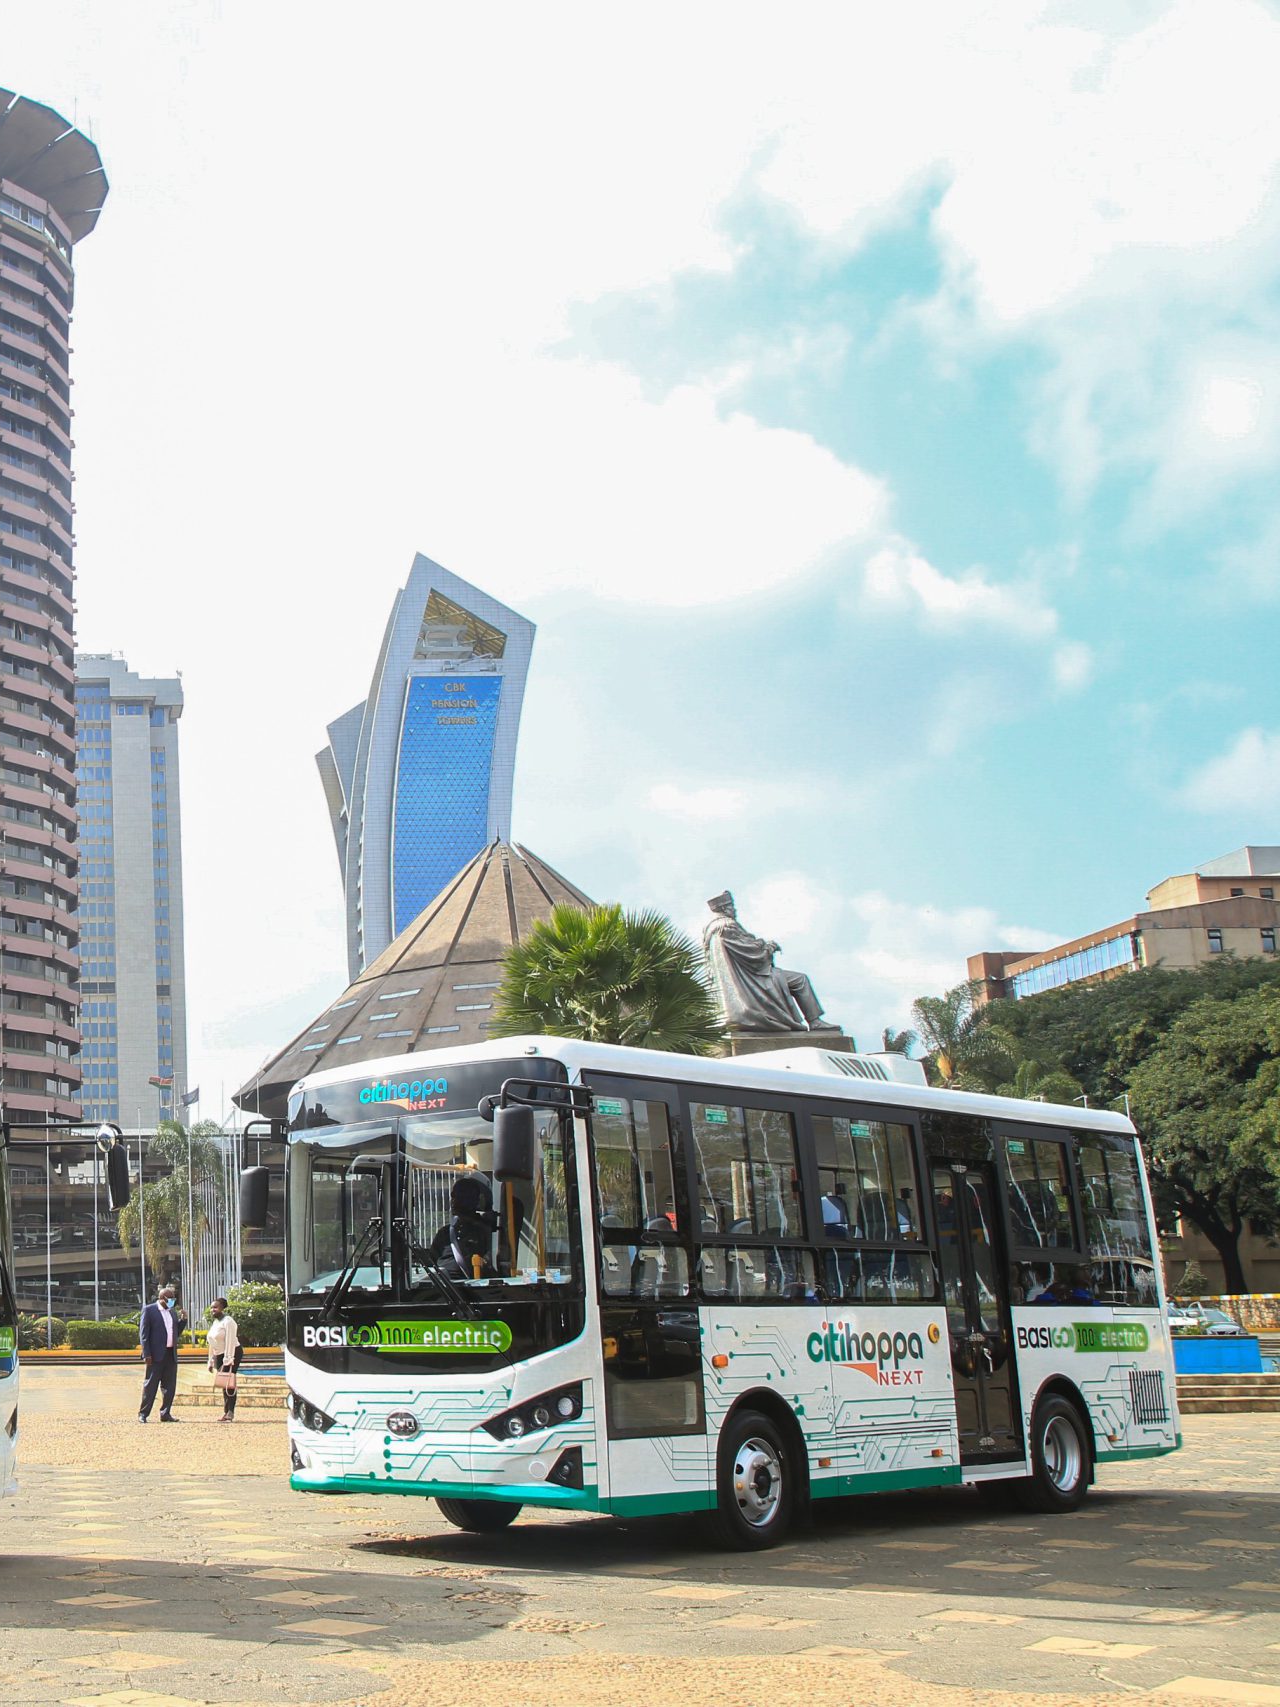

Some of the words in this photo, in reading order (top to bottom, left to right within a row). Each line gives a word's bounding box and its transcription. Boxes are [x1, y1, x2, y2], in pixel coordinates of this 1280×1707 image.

[444, 683, 465, 692] CBK
[431, 699, 478, 708] PENSION
[359, 1077, 448, 1105] citihoppa
[408, 1098, 447, 1111] NEXT
[423, 1325, 502, 1348] electric
[806, 1321, 924, 1371] citihoppa
[1101, 1326, 1145, 1348] electric
[879, 1370, 924, 1386] NEXT
